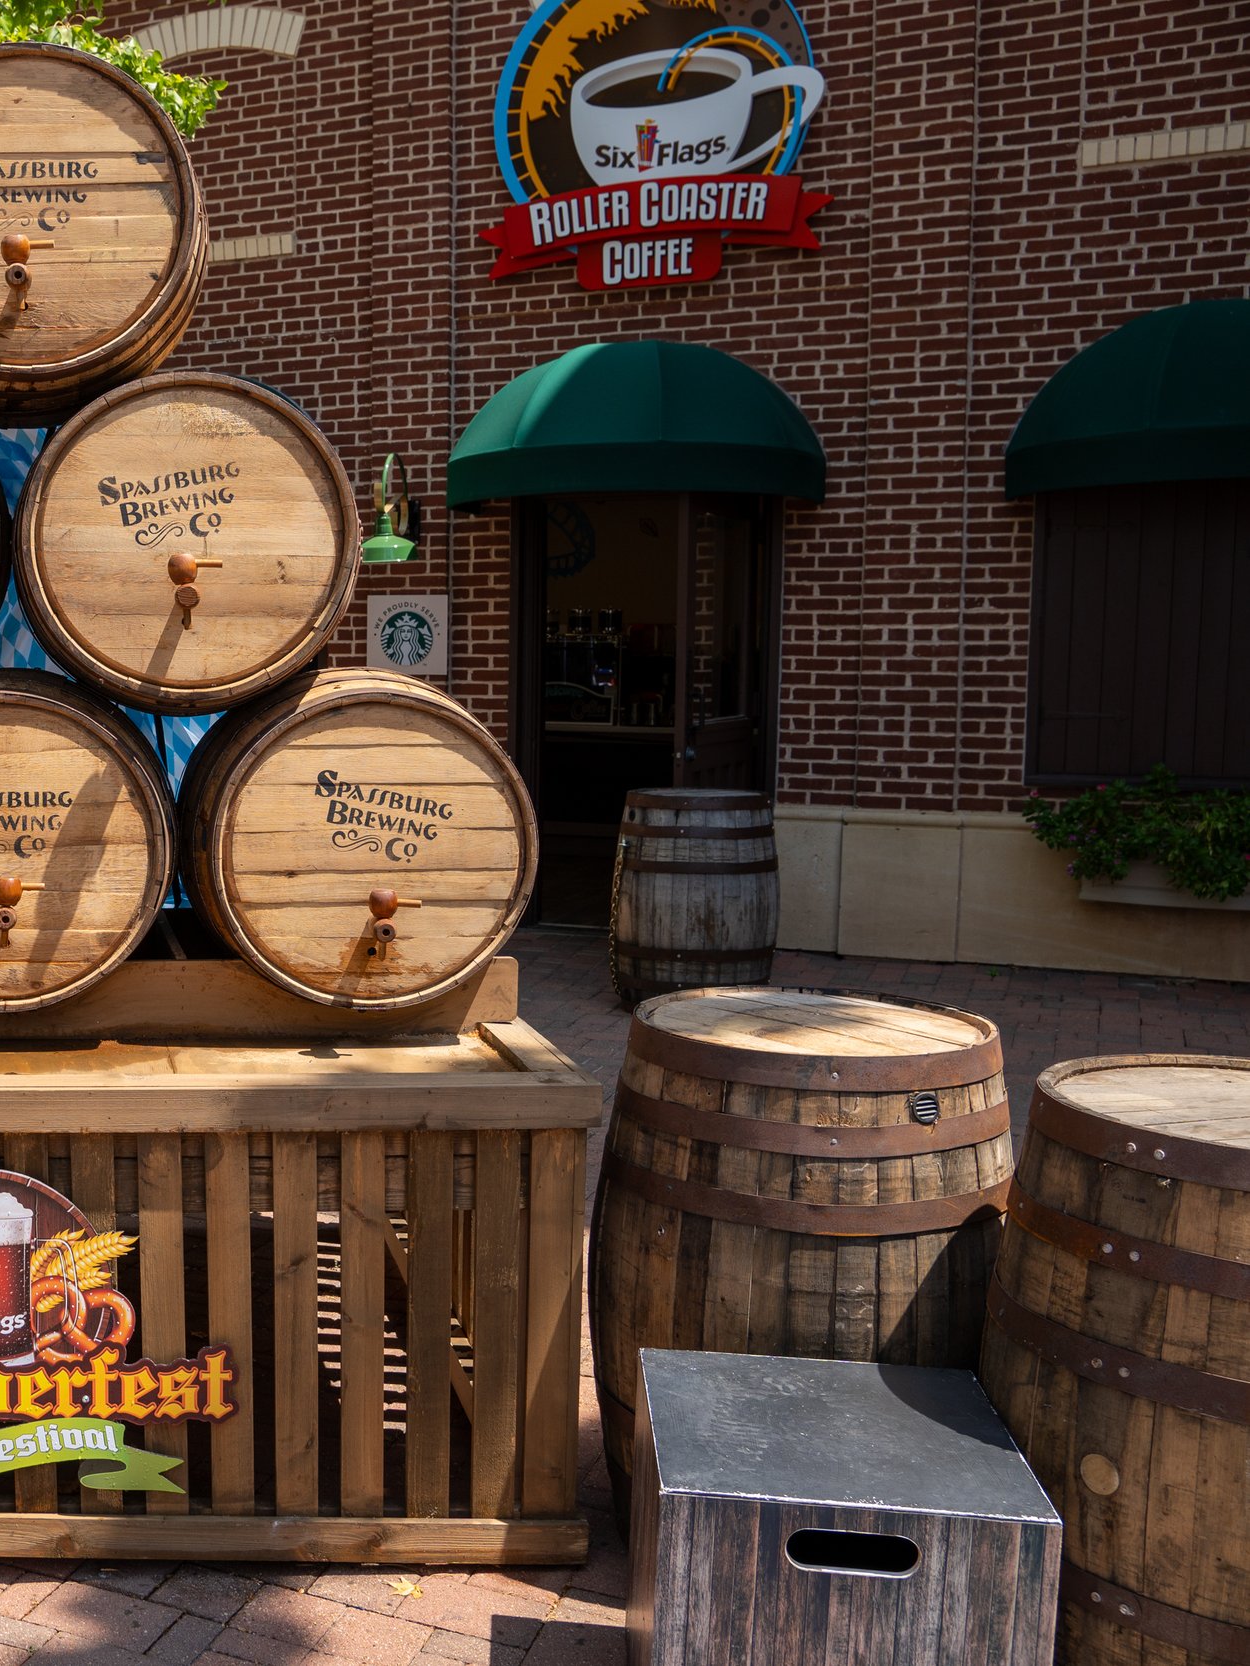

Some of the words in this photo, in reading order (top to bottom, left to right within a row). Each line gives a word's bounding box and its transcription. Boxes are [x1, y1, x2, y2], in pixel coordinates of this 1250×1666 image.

[594, 144, 636, 168] Six
[657, 135, 726, 166] Flags
[529, 188, 631, 247] ROLLER
[639, 181, 769, 229] COASTER
[602, 237, 694, 287] COFFEE
[119, 486, 235, 527] BREWING
[374, 617, 384, 630] WE
[382, 602, 419, 616] PROUDLY
[421, 606, 441, 628] SERVE
[326, 799, 438, 841] BREWING
